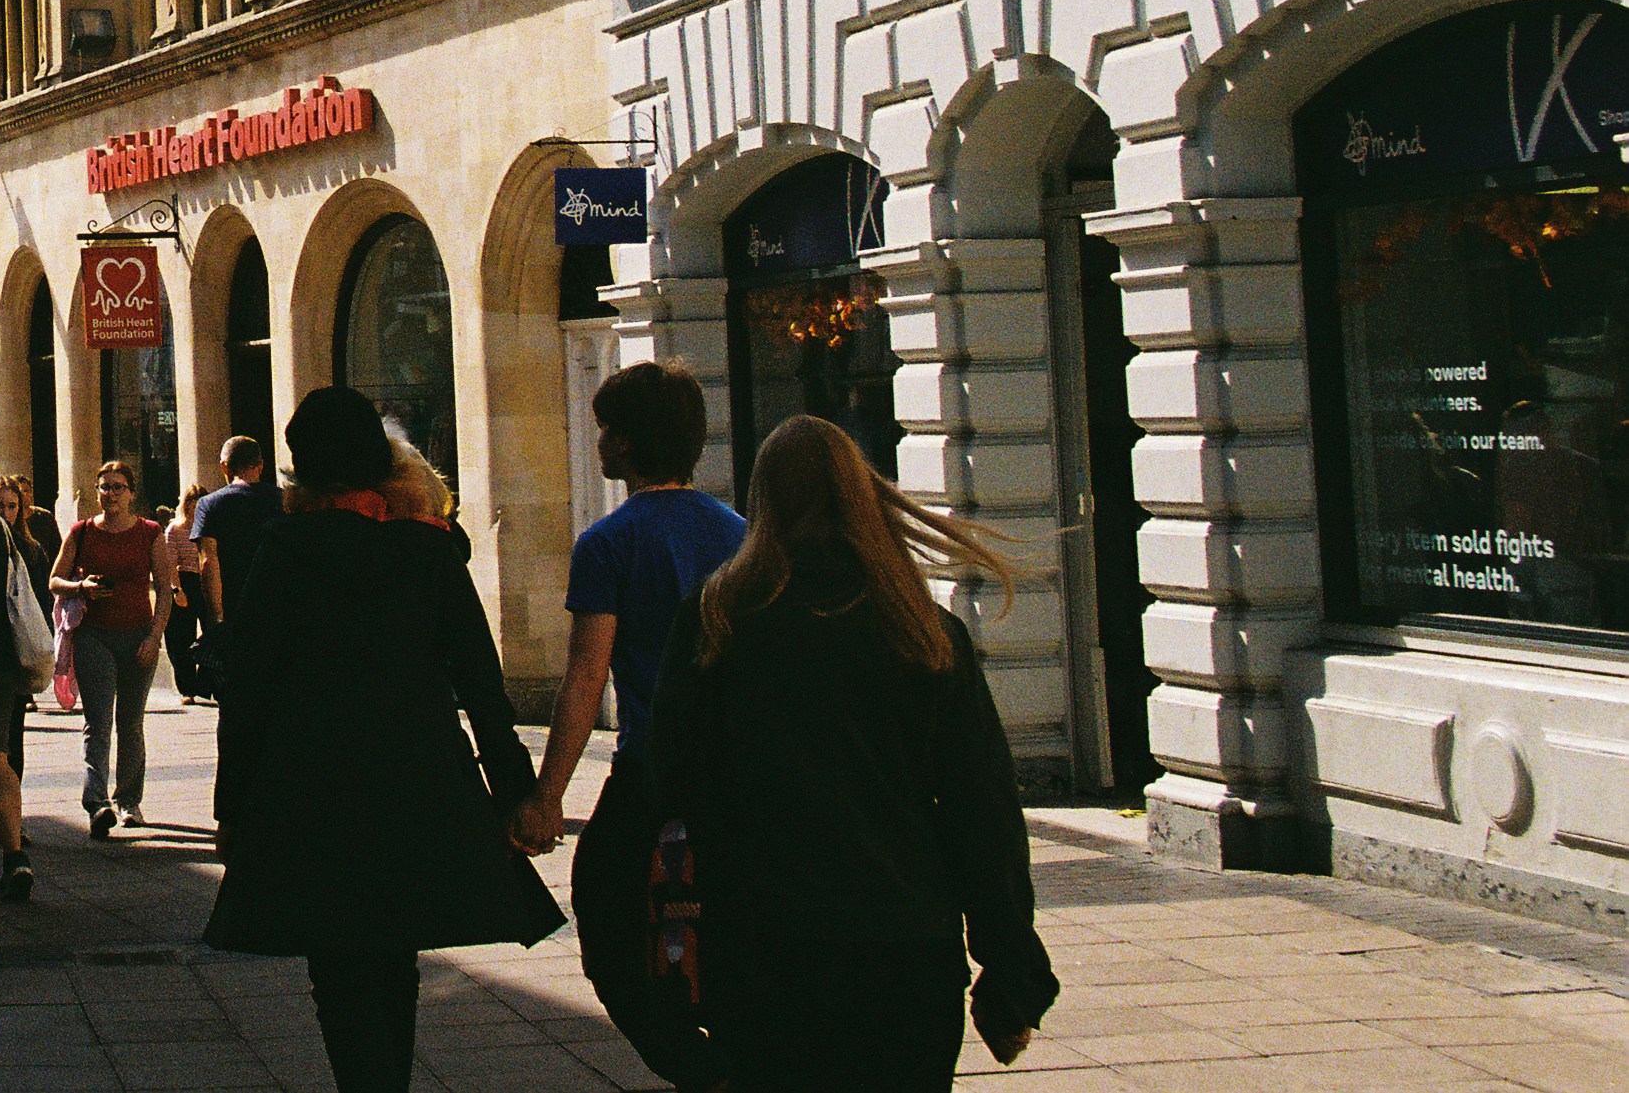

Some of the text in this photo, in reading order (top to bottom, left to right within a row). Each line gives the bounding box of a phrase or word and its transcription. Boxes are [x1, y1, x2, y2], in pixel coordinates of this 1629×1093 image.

[86, 75, 370, 196] British Heart Foundation
[1371, 124, 1427, 159] mind
[589, 199, 643, 218] mind
[92, 317, 154, 328] British Heart
[92, 329, 155, 340] Foundation
[1470, 435, 1495, 450] our
[1498, 431, 1545, 450] team.
[1451, 530, 1493, 555] sold
[1494, 528, 1556, 564] fights
[1453, 564, 1521, 593] health.
